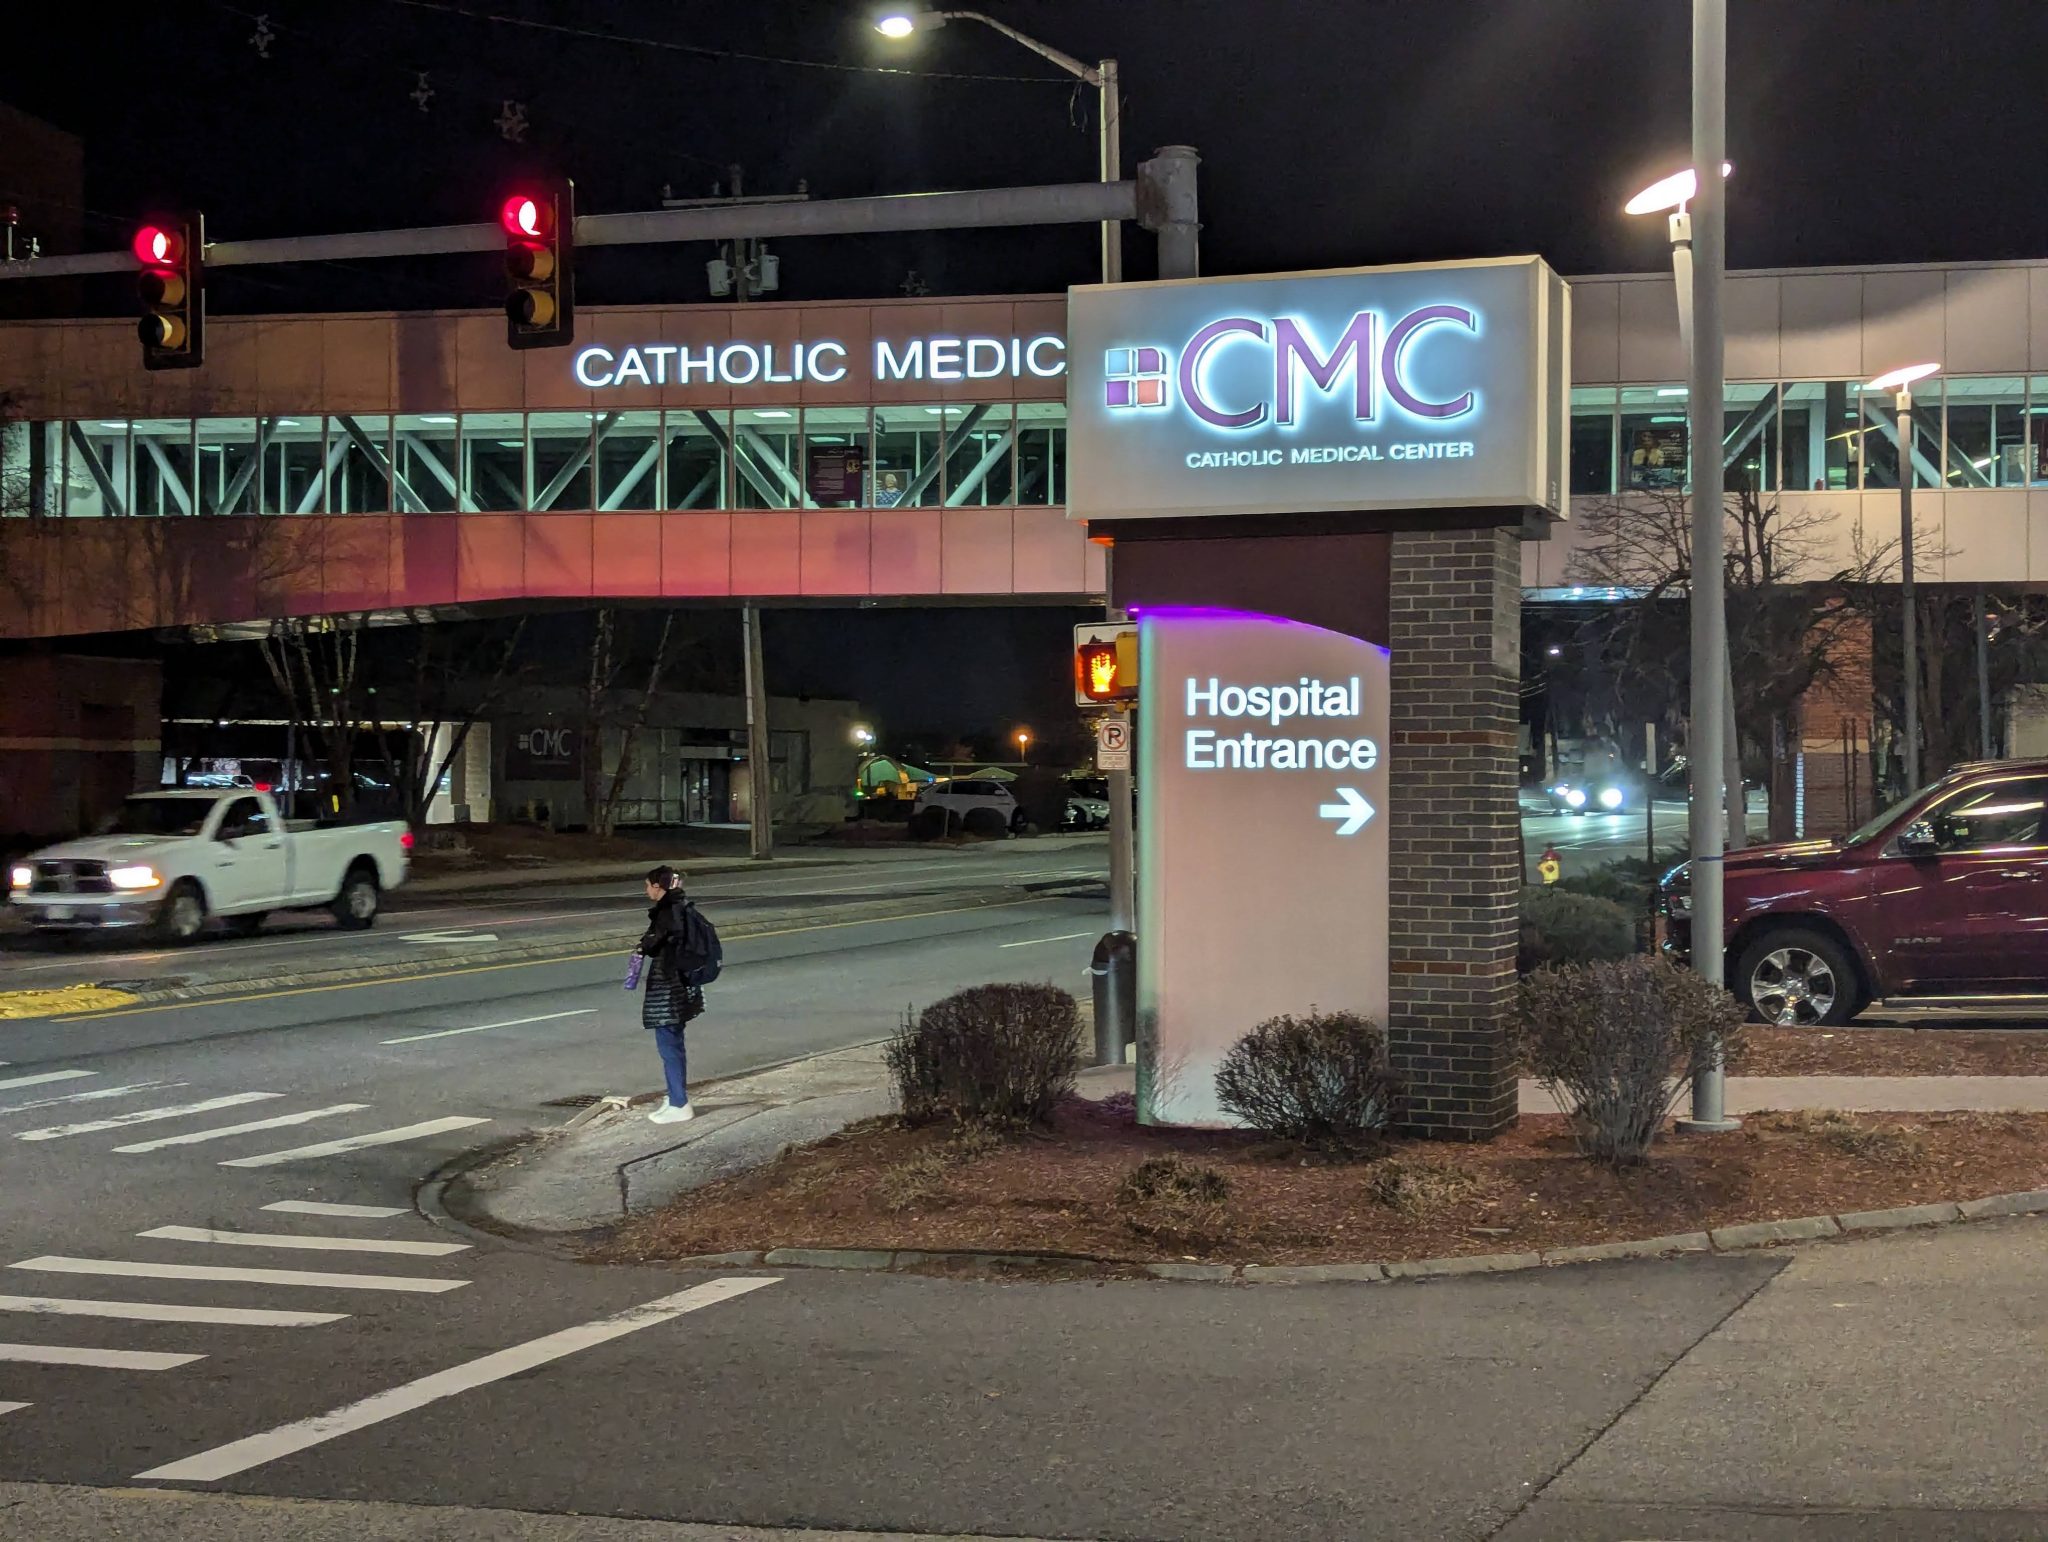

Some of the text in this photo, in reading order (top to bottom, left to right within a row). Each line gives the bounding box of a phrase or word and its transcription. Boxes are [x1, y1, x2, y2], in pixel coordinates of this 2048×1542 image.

[576, 336, 1068, 387] CATHOLIC MEDIC
[1179, 305, 1476, 428] CMC
[1187, 441, 1475, 469] CATHOLIC MEDICAL CENTER
[1187, 677, 1360, 726] Hospital
[529, 728, 572, 756] CMC
[1186, 730, 1377, 770] Entrance
